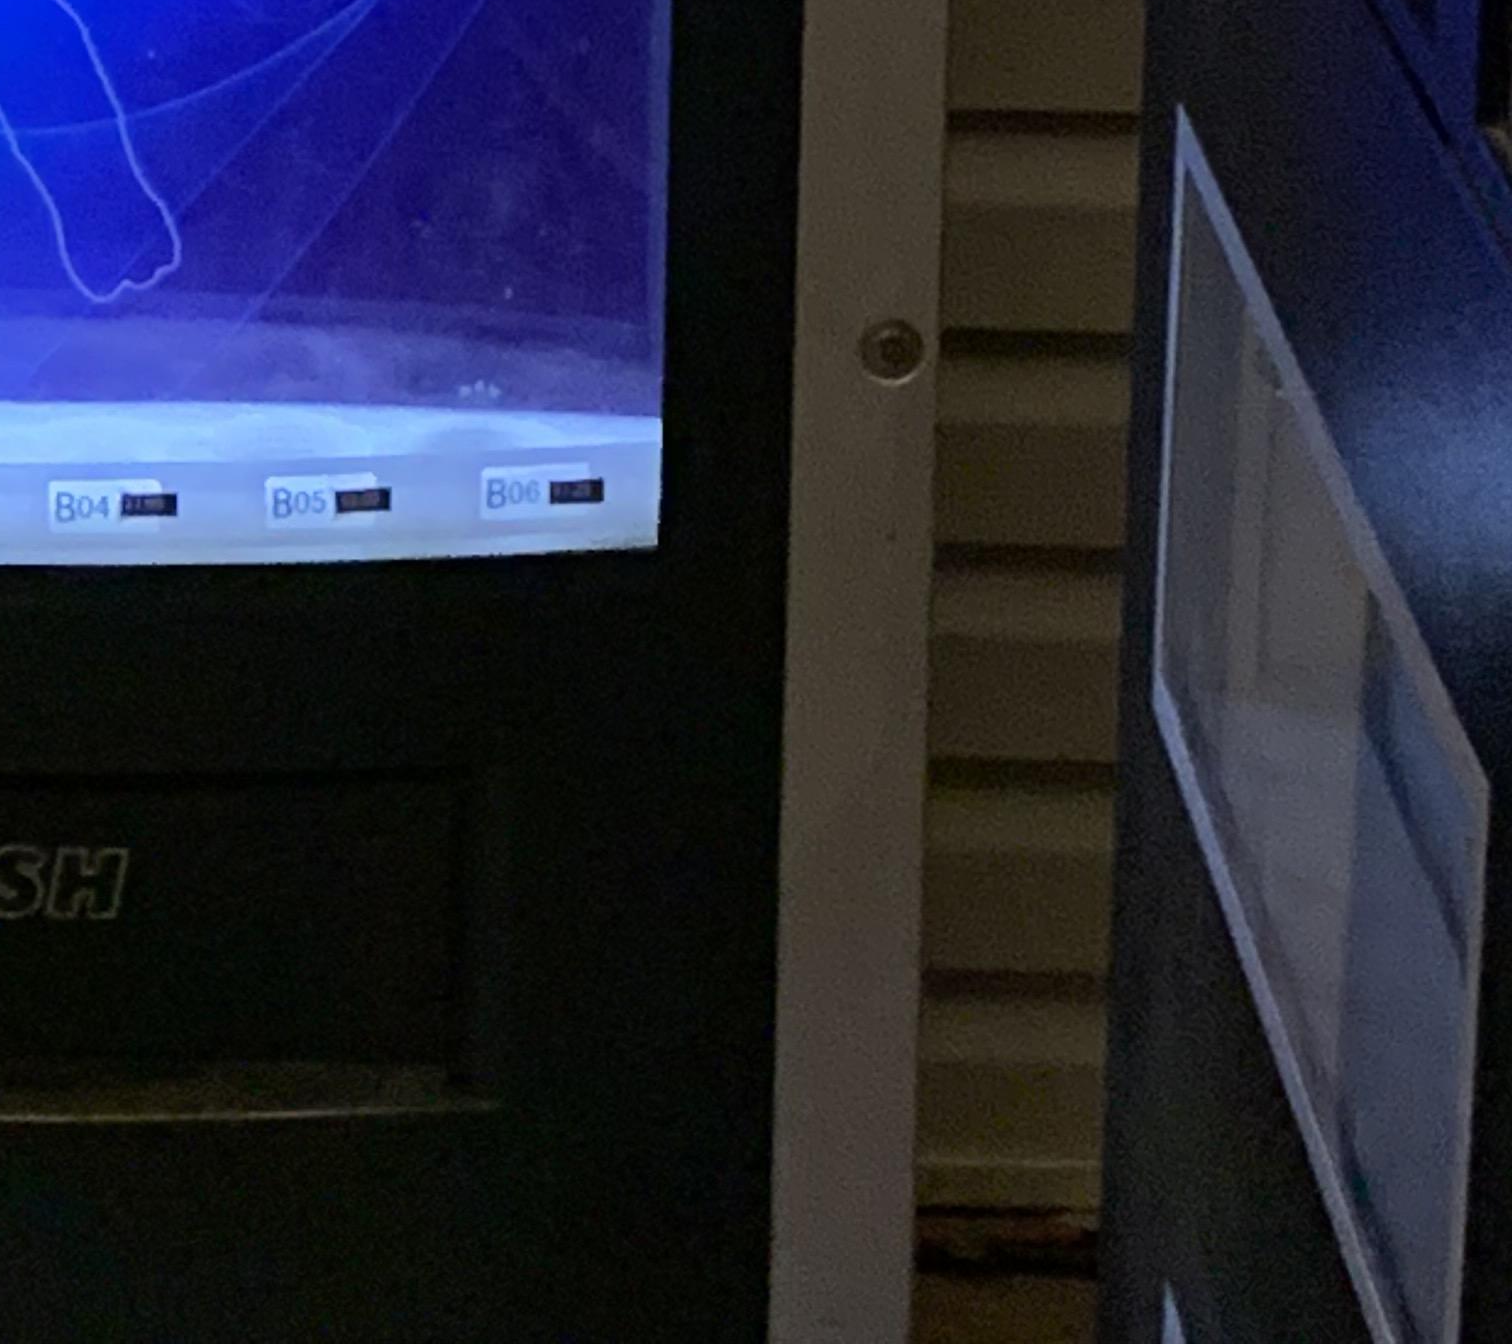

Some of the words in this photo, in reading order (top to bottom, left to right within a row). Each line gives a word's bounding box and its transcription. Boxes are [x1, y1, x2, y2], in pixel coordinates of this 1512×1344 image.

[53, 490, 110, 523] B04
[271, 487, 328, 521] B05
[485, 476, 542, 510] B06
